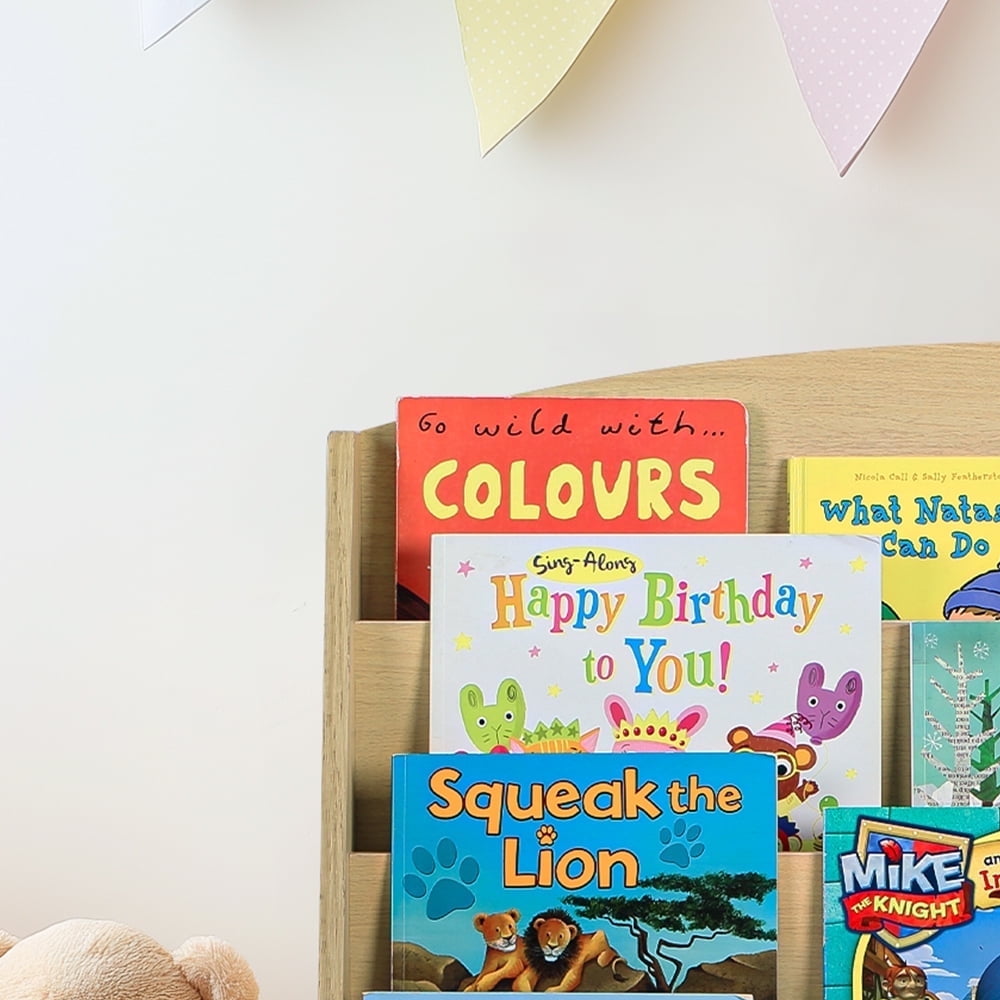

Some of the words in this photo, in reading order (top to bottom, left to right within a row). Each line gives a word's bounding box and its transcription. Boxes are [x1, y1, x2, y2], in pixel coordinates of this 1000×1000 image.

[418, 412, 447, 436] Go
[474, 408, 572, 437] wild
[600, 410, 725, 437] with...
[422, 457, 720, 520] COLOURS
[854, 472, 886, 482] Nicola
[889, 472, 909, 482] Call
[911, 473, 919, 482] &
[922, 472, 947, 484] Sally
[820, 494, 902, 526] What
[881, 530, 938, 558] Can
[951, 531, 990, 558] Do
[533, 551, 637, 577] Sing-Along
[490, 573, 626, 633] Happy
[638, 571, 824, 634] Birthday
[582, 650, 614, 684] to
[624, 638, 733, 694] You!
[427, 767, 662, 836] Squeak
[667, 774, 743, 814] the
[502, 824, 640, 890] Lion
[850, 898, 872, 914] THE
[873, 896, 961, 921] KNIGHT
